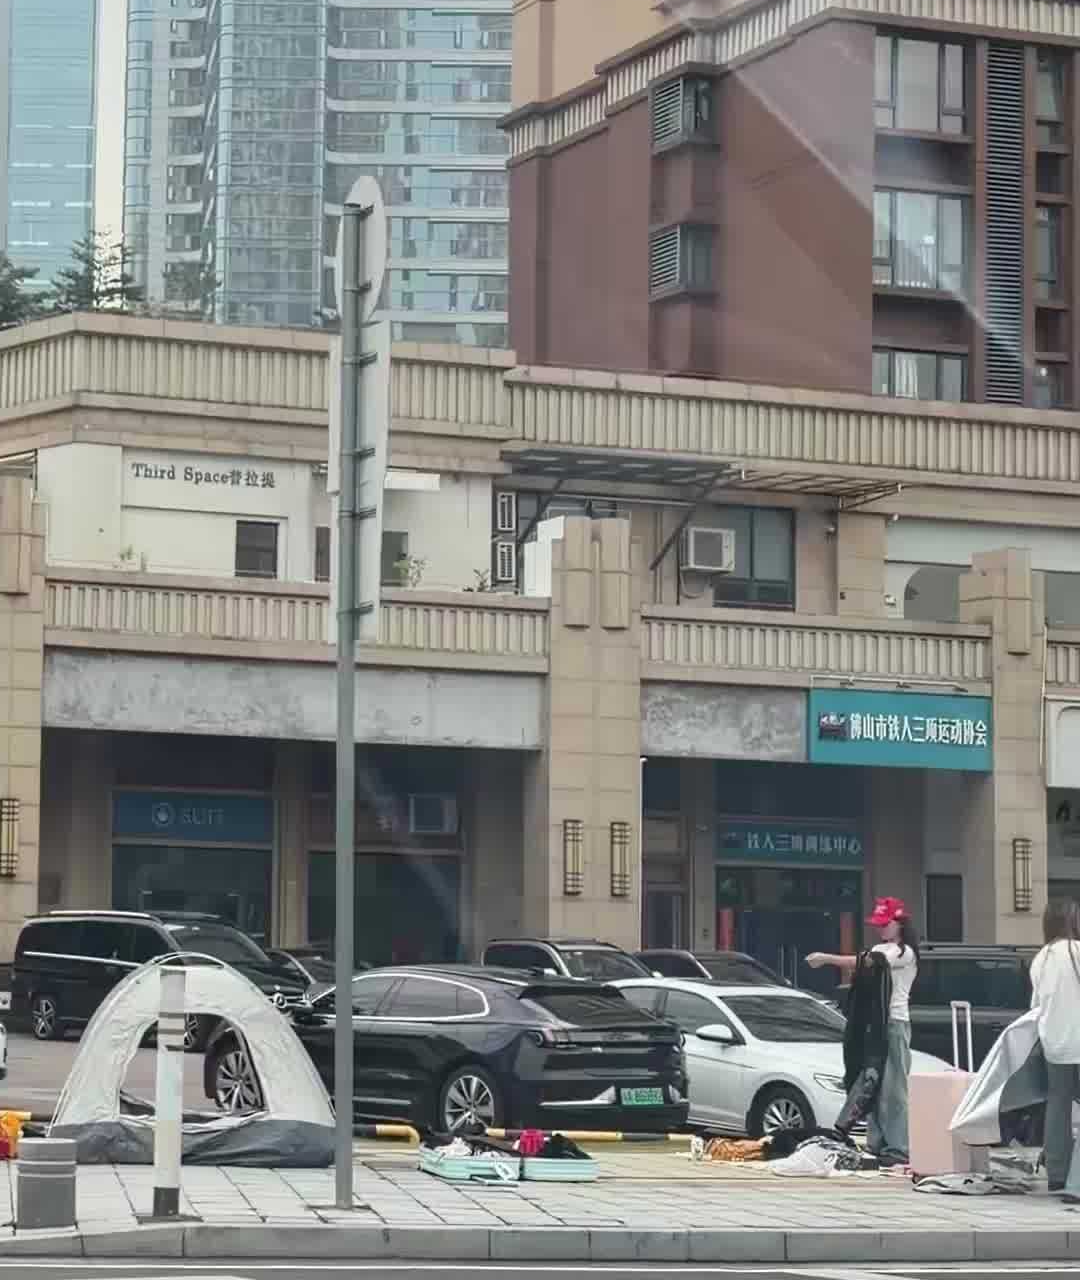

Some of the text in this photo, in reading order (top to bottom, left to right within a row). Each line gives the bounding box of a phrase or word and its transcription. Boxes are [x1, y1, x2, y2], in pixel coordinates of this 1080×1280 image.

[131, 463, 176, 480] Third
[850, 712, 988, 747] 佛山市铁人三项运动协会
